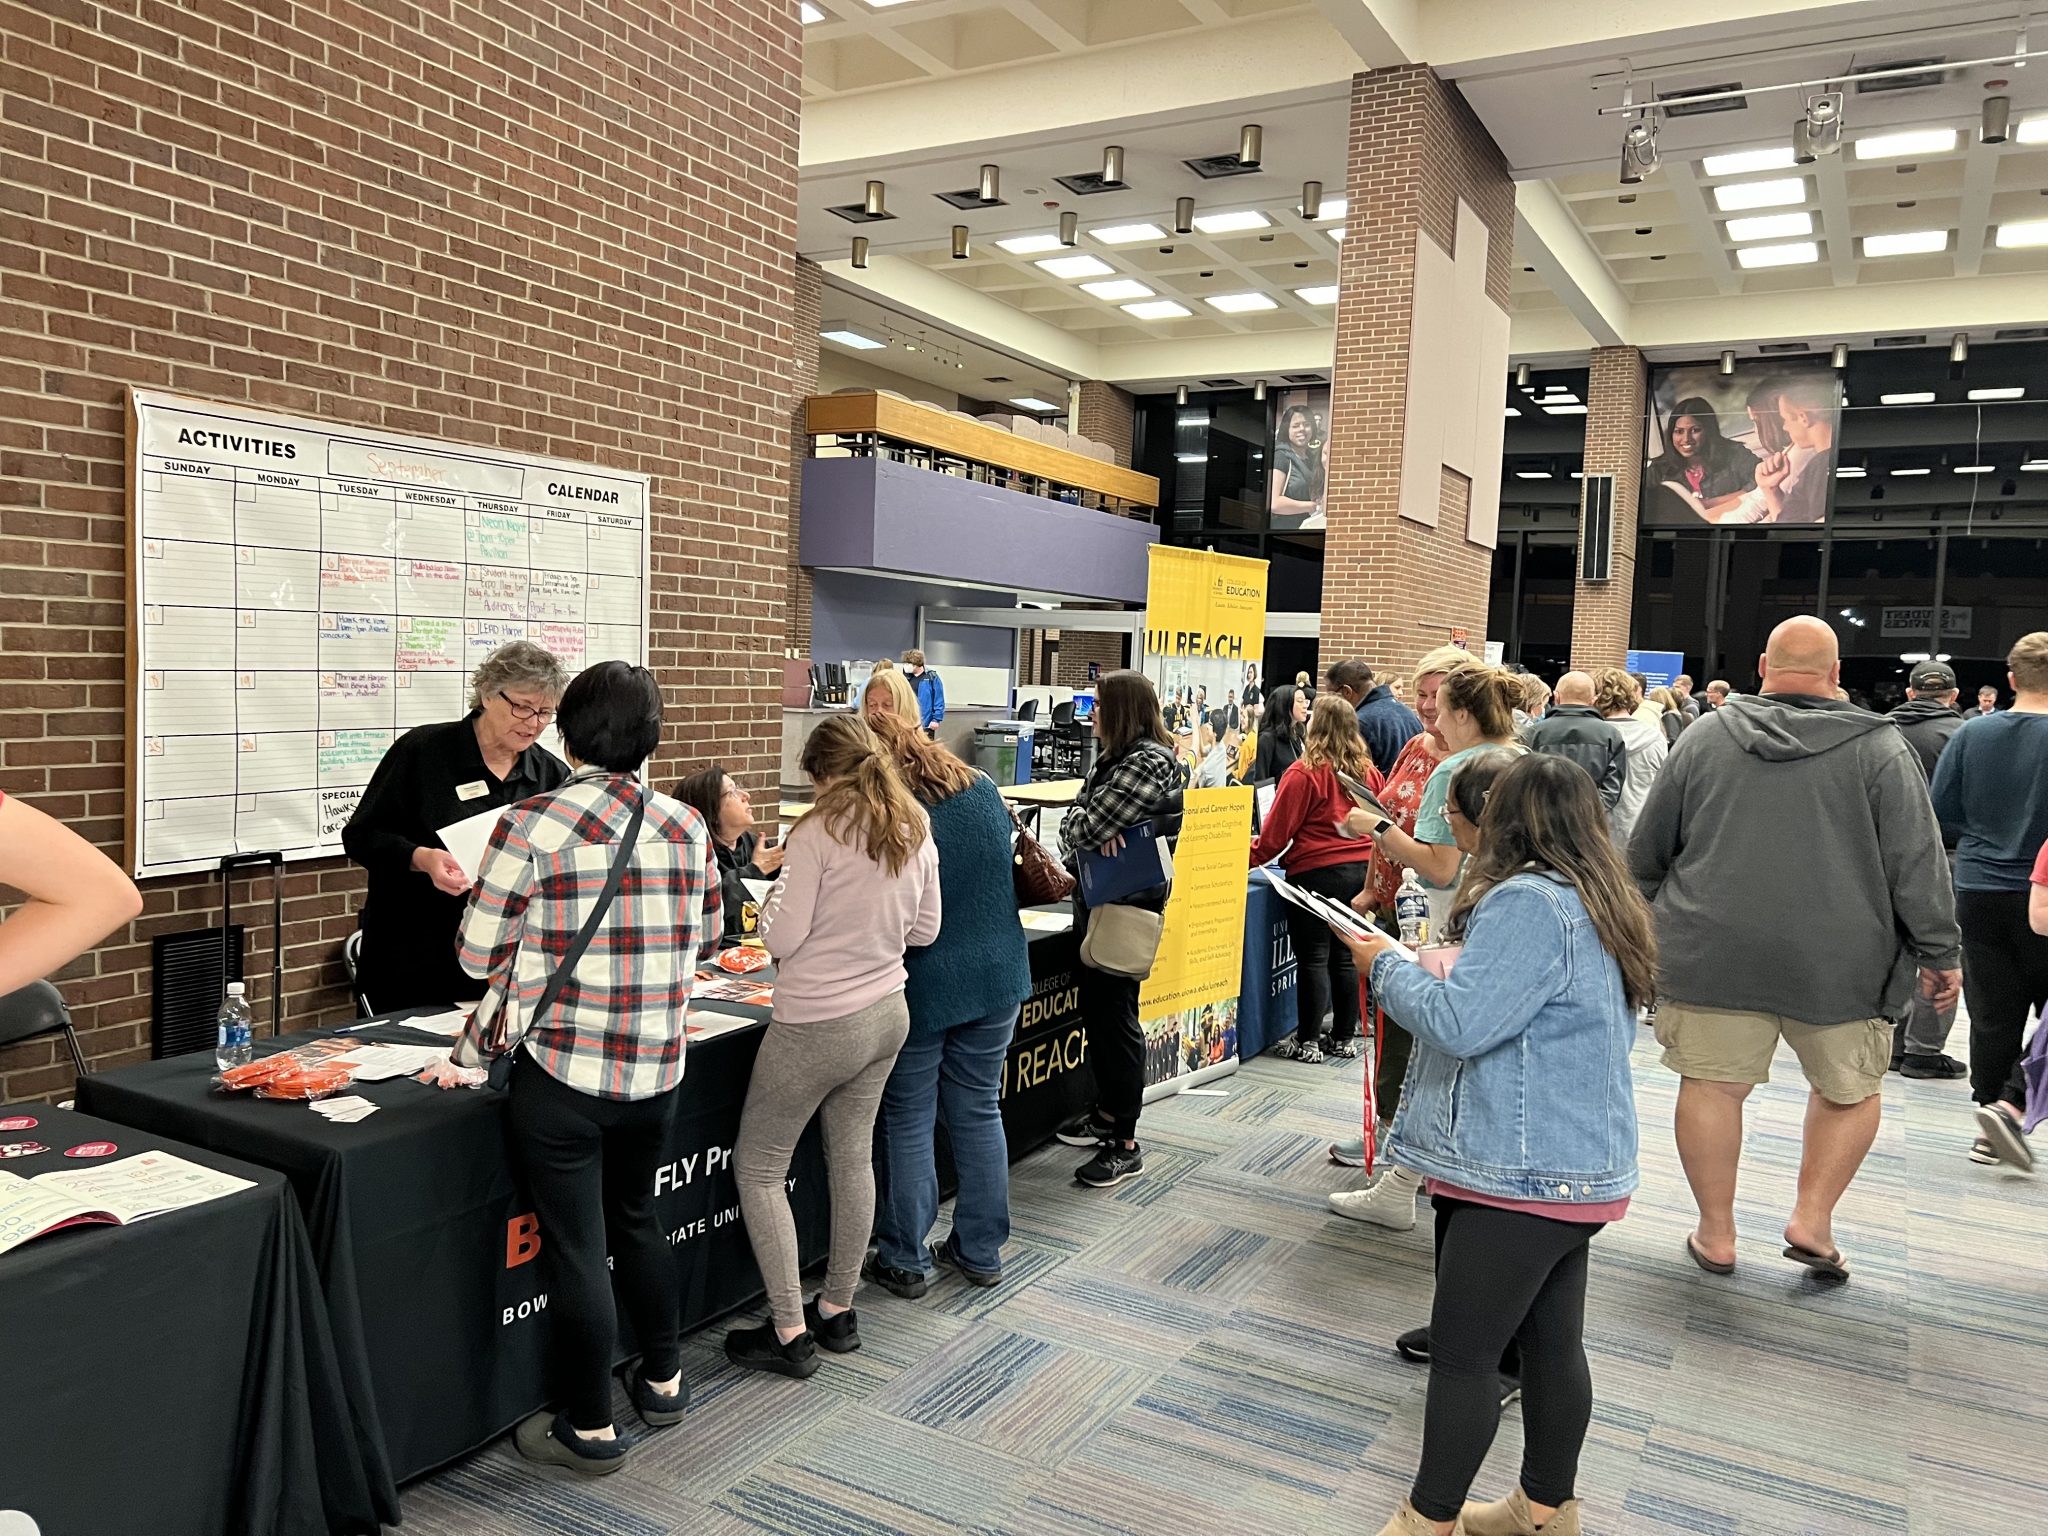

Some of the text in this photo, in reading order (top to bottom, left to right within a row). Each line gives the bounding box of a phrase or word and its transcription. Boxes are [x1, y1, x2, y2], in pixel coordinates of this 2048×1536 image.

[178, 428, 296, 459] ACTIVITIES
[164, 461, 211, 475] SUNDAY
[257, 474, 300, 486] MONDAY
[338, 484, 379, 496] TUESDAY
[548, 482, 619, 504] CALENDAR
[405, 492, 457, 505] WEDNESDAY
[478, 501, 519, 513] THURSDAY
[547, 510, 570, 519] FRIDAY
[598, 516, 632, 526] SATURDAY
[482, 567, 506, 578] Student
[1226, 586, 1260, 598] EDUCATION
[1148, 629, 1242, 659] UI REACH
[322, 791, 361, 800] SPECIAL
[1200, 804, 1210, 813] and
[1211, 804, 1228, 812] Career
[1273, 919, 1288, 936] UNI
[1272, 934, 1296, 970] ILL
[1060, 971, 1072, 986] OF
[1021, 986, 1079, 1029] EDUCAT
[506, 1146, 732, 1269] B FLY Pr
[503, 1204, 740, 1326] BOW TATE UNI
